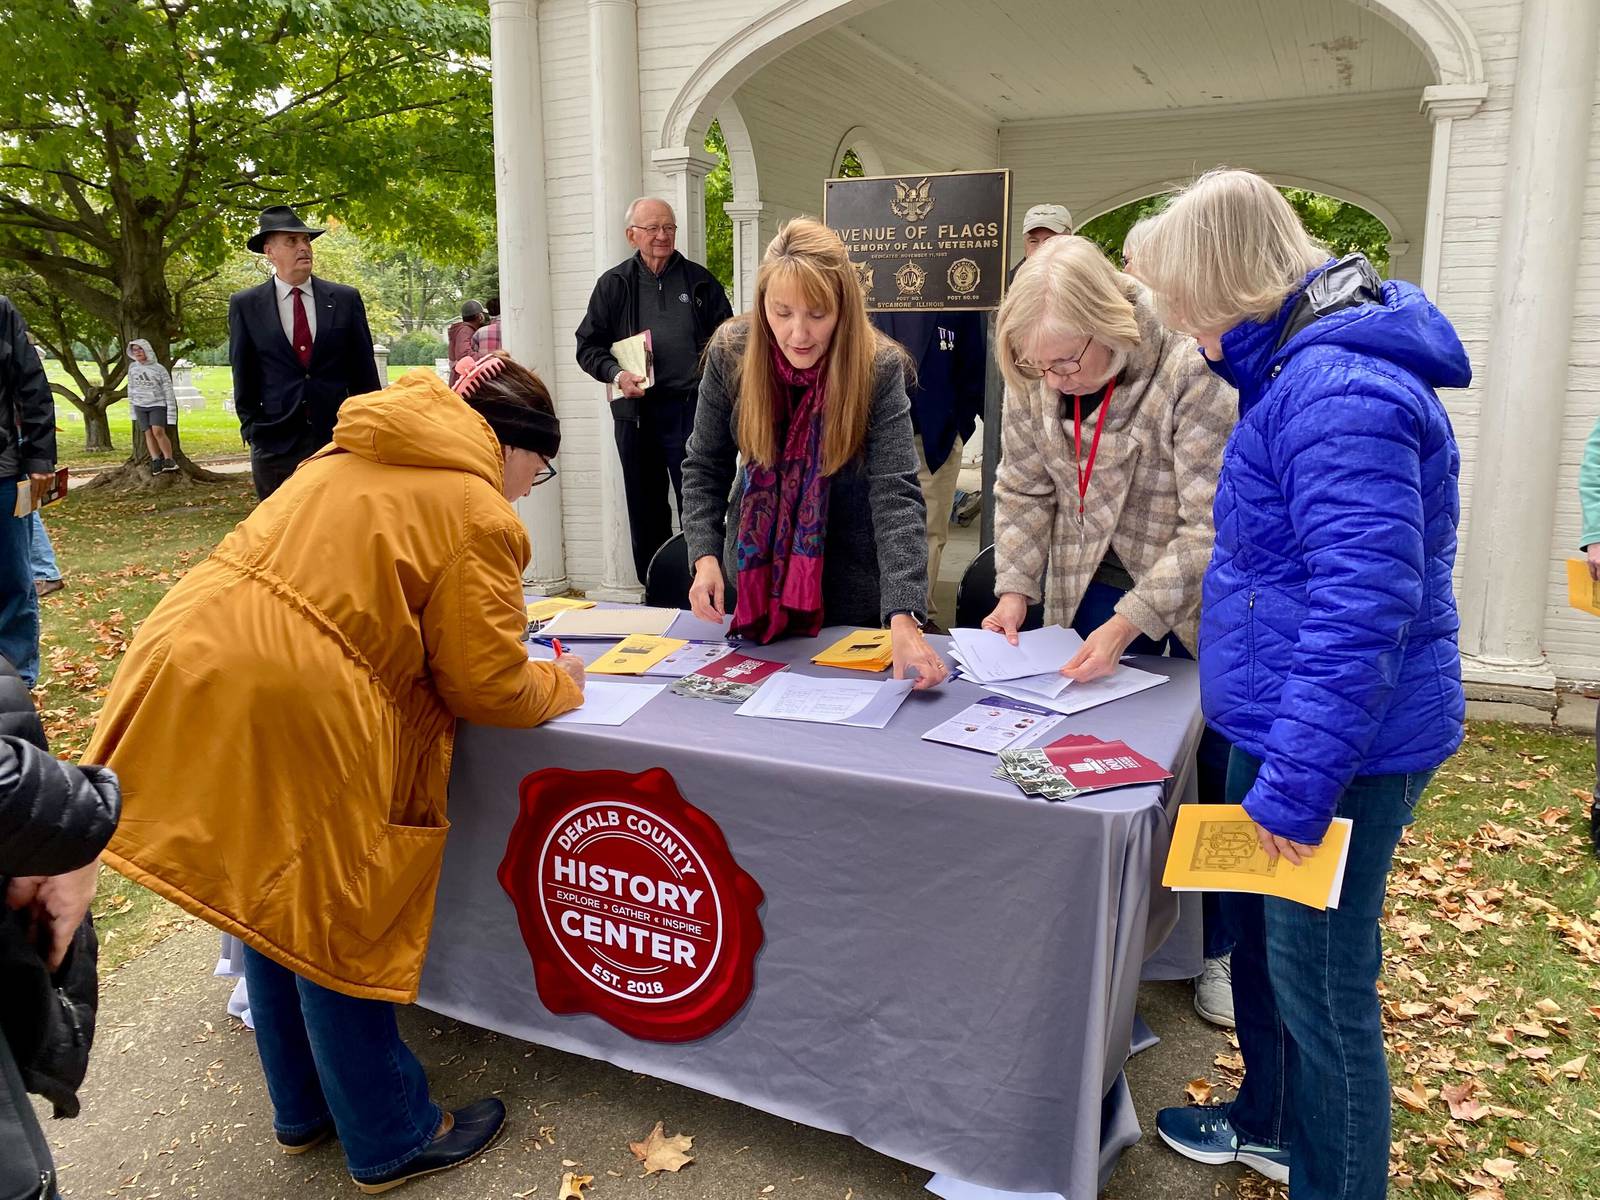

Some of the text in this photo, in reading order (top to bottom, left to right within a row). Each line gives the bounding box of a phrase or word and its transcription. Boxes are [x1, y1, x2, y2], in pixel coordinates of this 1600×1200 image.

[894, 242, 908, 251] OF
[913, 241, 934, 250] ALL
[938, 239, 999, 249] VETERANS
[905, 226, 927, 240] OF
[938, 223, 998, 238] FLAGS
[557, 810, 697, 876] DEKALB COUNTY
[554, 855, 704, 914] HISTORY
[556, 890, 702, 935] EXPLORE GATHER INSPIRE
[560, 909, 697, 969] CENTER
[591, 962, 664, 995] EST. 2018
